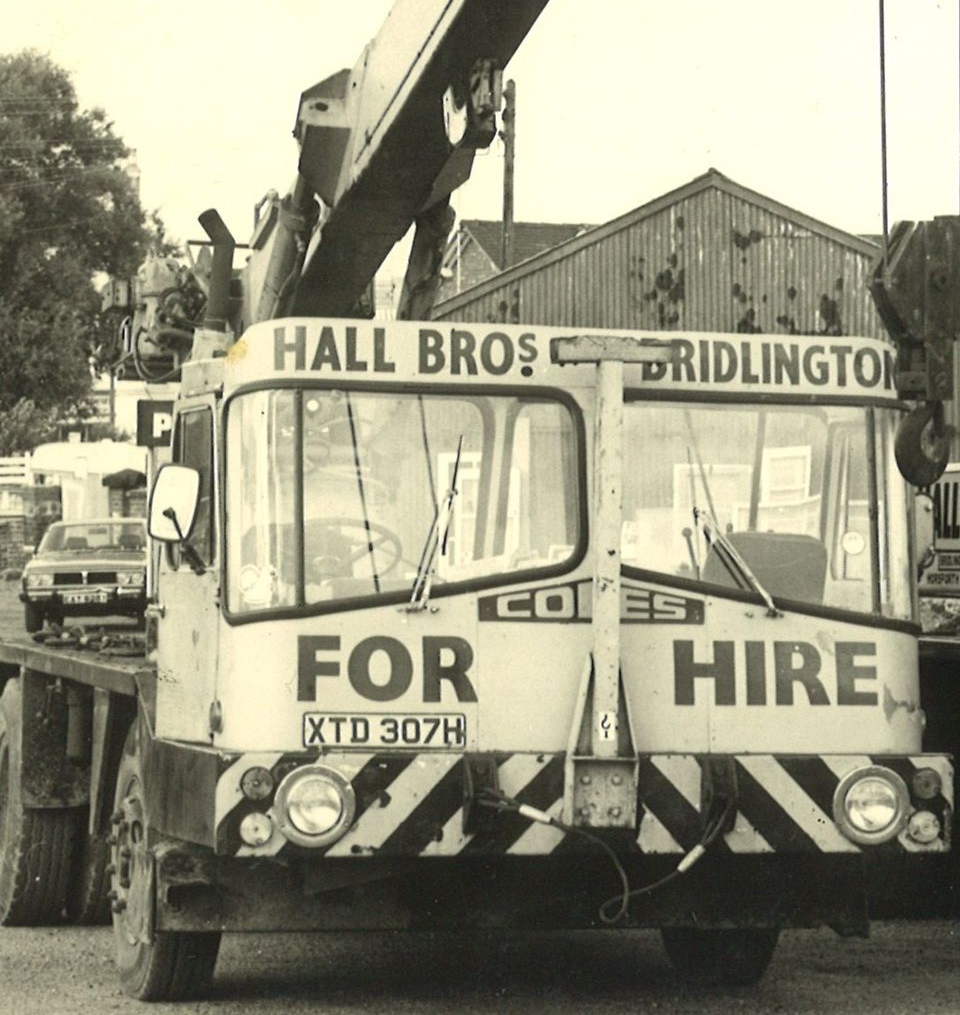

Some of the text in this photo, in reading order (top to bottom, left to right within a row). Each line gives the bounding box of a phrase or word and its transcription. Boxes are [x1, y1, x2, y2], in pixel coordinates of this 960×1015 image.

[273, 325, 396, 374] HALL
[924, 482, 960, 540] ALL
[297, 634, 879, 707] FOR HIRE
[308, 717, 463, 745] XTD 307H
